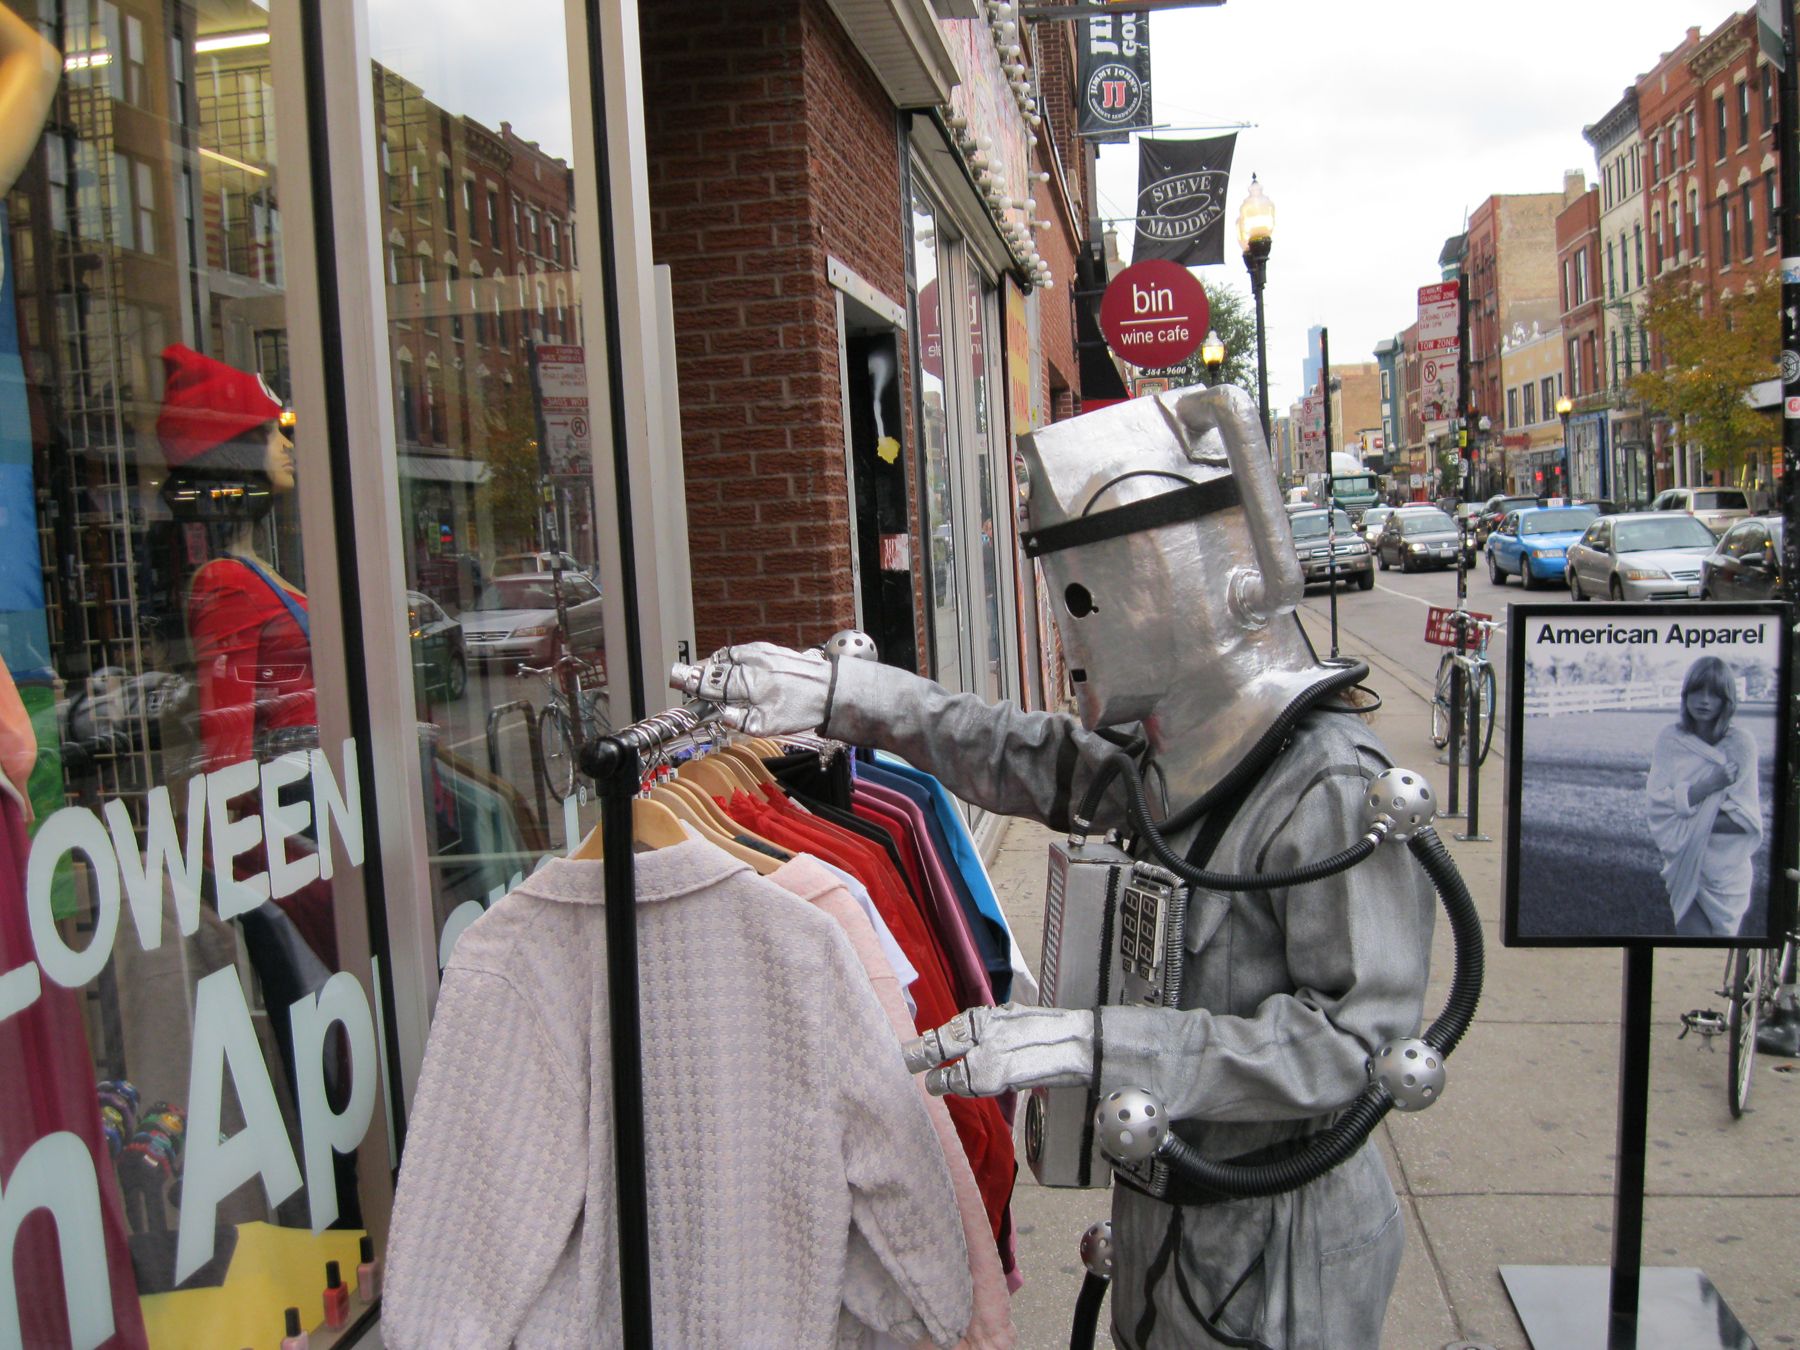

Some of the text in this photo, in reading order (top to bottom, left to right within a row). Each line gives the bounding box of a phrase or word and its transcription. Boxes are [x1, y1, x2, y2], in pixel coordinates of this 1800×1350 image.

[1090, 67, 1111, 95] JIMMY
[1102, 80, 1126, 108] JJ
[1152, 175, 1211, 202] STEVE
[1147, 200, 1221, 237] MADDEN
[1132, 282, 1173, 314] bin
[1120, 324, 1189, 345] wine cafe
[1420, 337, 1455, 350] TOW ZONE
[1536, 623, 1764, 648] American Apparel
